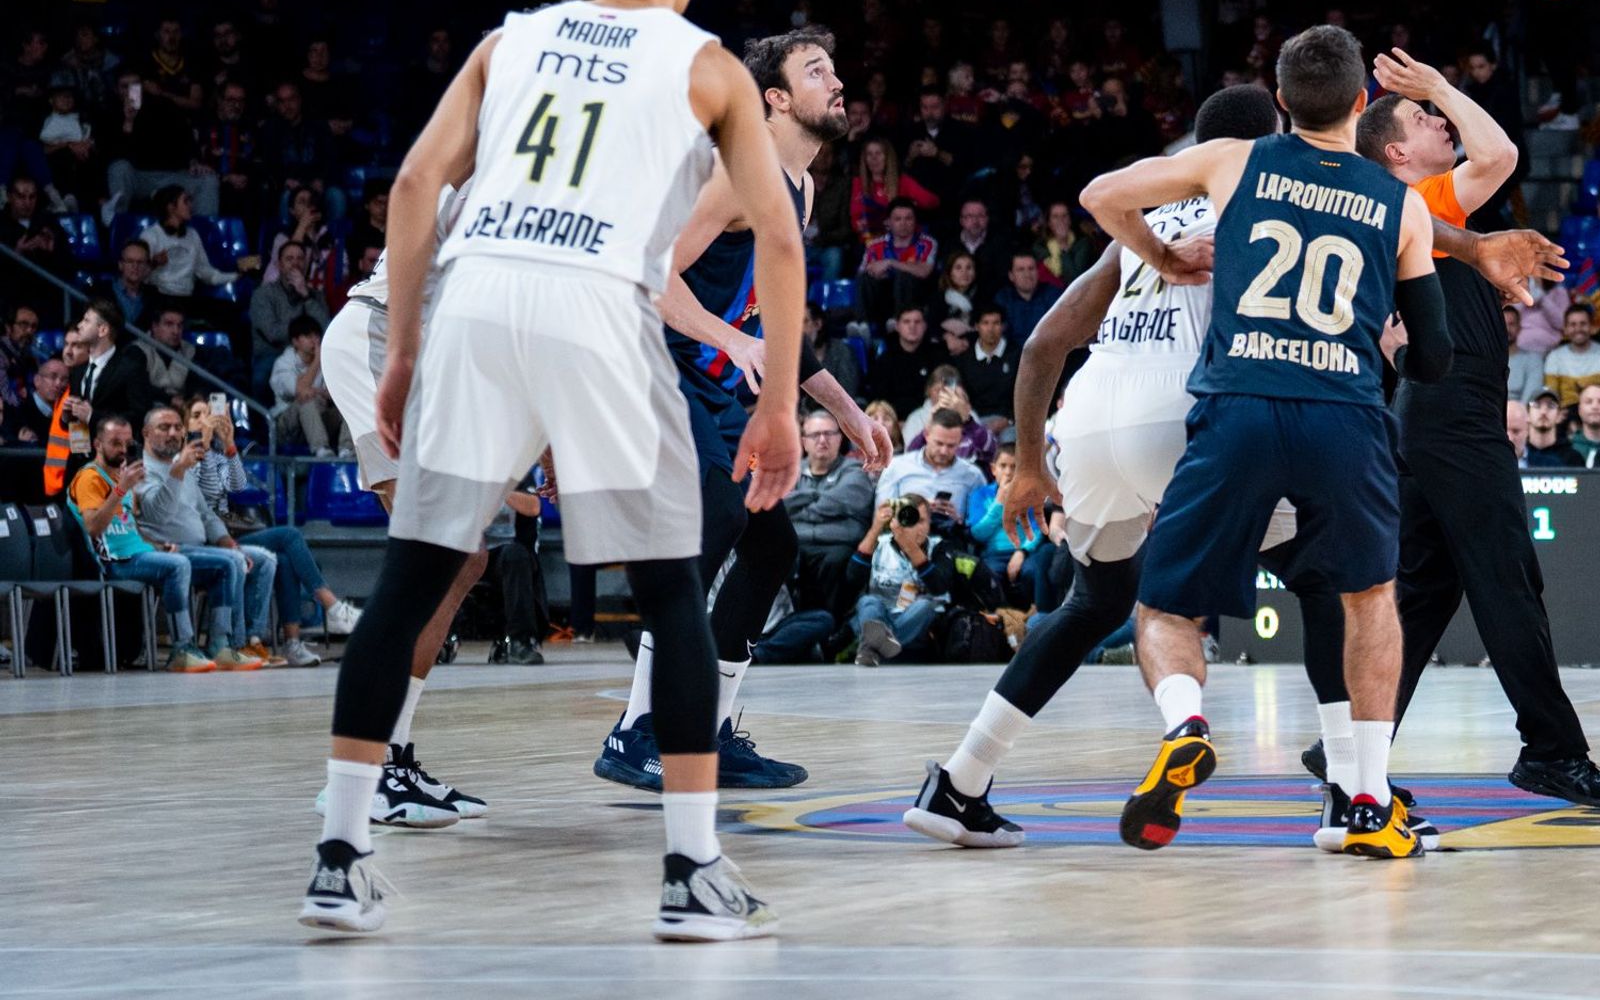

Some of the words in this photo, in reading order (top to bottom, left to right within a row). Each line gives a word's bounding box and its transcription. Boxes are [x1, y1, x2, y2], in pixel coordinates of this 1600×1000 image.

[556, 17, 638, 49] MADAR
[537, 50, 629, 85] mts
[514, 92, 606, 188] 41
[1255, 171, 1388, 231] LAPROVITTOLA
[1236, 219, 1365, 336] 20
[1228, 331, 1360, 375] BARCELONA
[1521, 476, 1578, 495] RIODE
[1532, 507, 1555, 540] 1
[1254, 606, 1279, 641] 0
